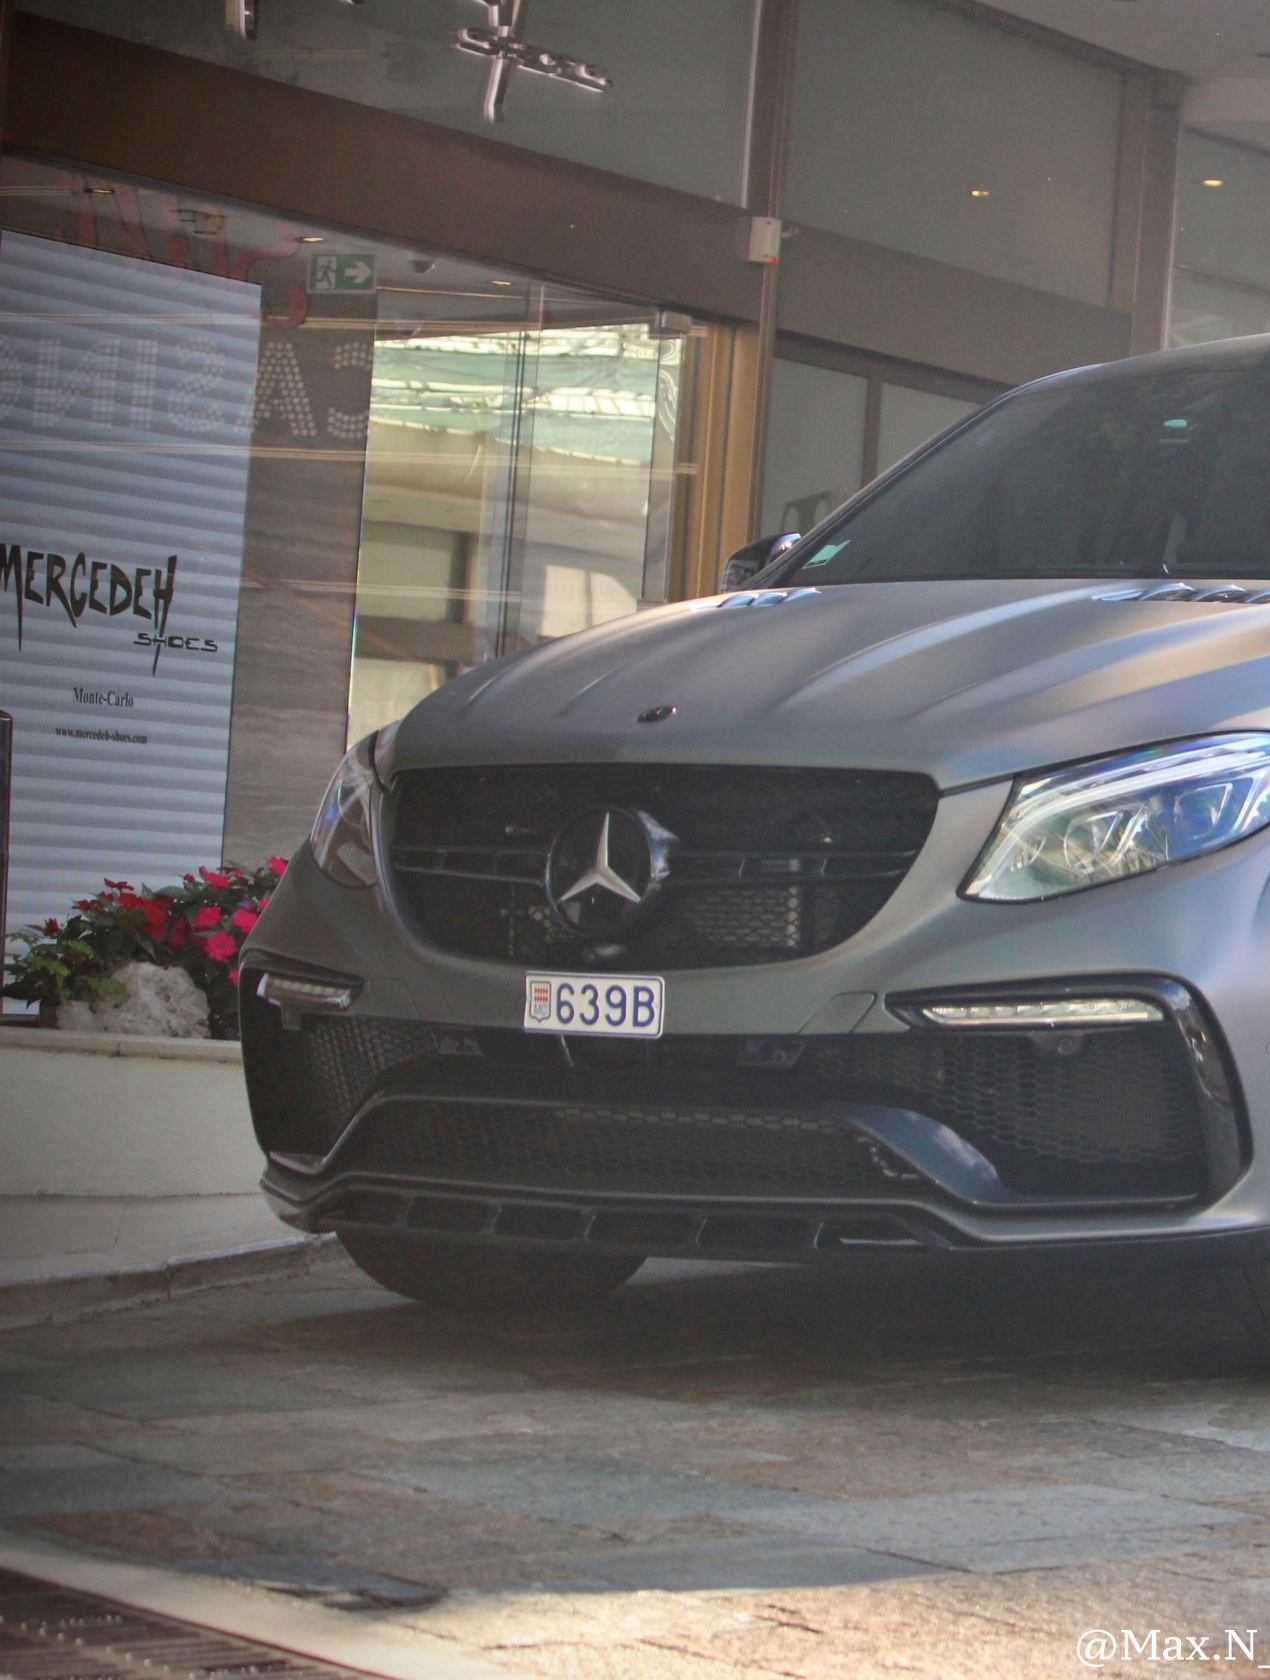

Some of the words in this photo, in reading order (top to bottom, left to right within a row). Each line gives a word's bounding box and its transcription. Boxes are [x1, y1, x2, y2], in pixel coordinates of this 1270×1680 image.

[0, 544, 178, 677] MERCEDEH
[133, 632, 218, 652] SHOES
[73, 687, 134, 708] Monte-Carlo
[55, 728, 148, 745] www.mercedeh-shoes.com
[534, 1003, 547, 1015] MC
[556, 983, 655, 1027] 639B
